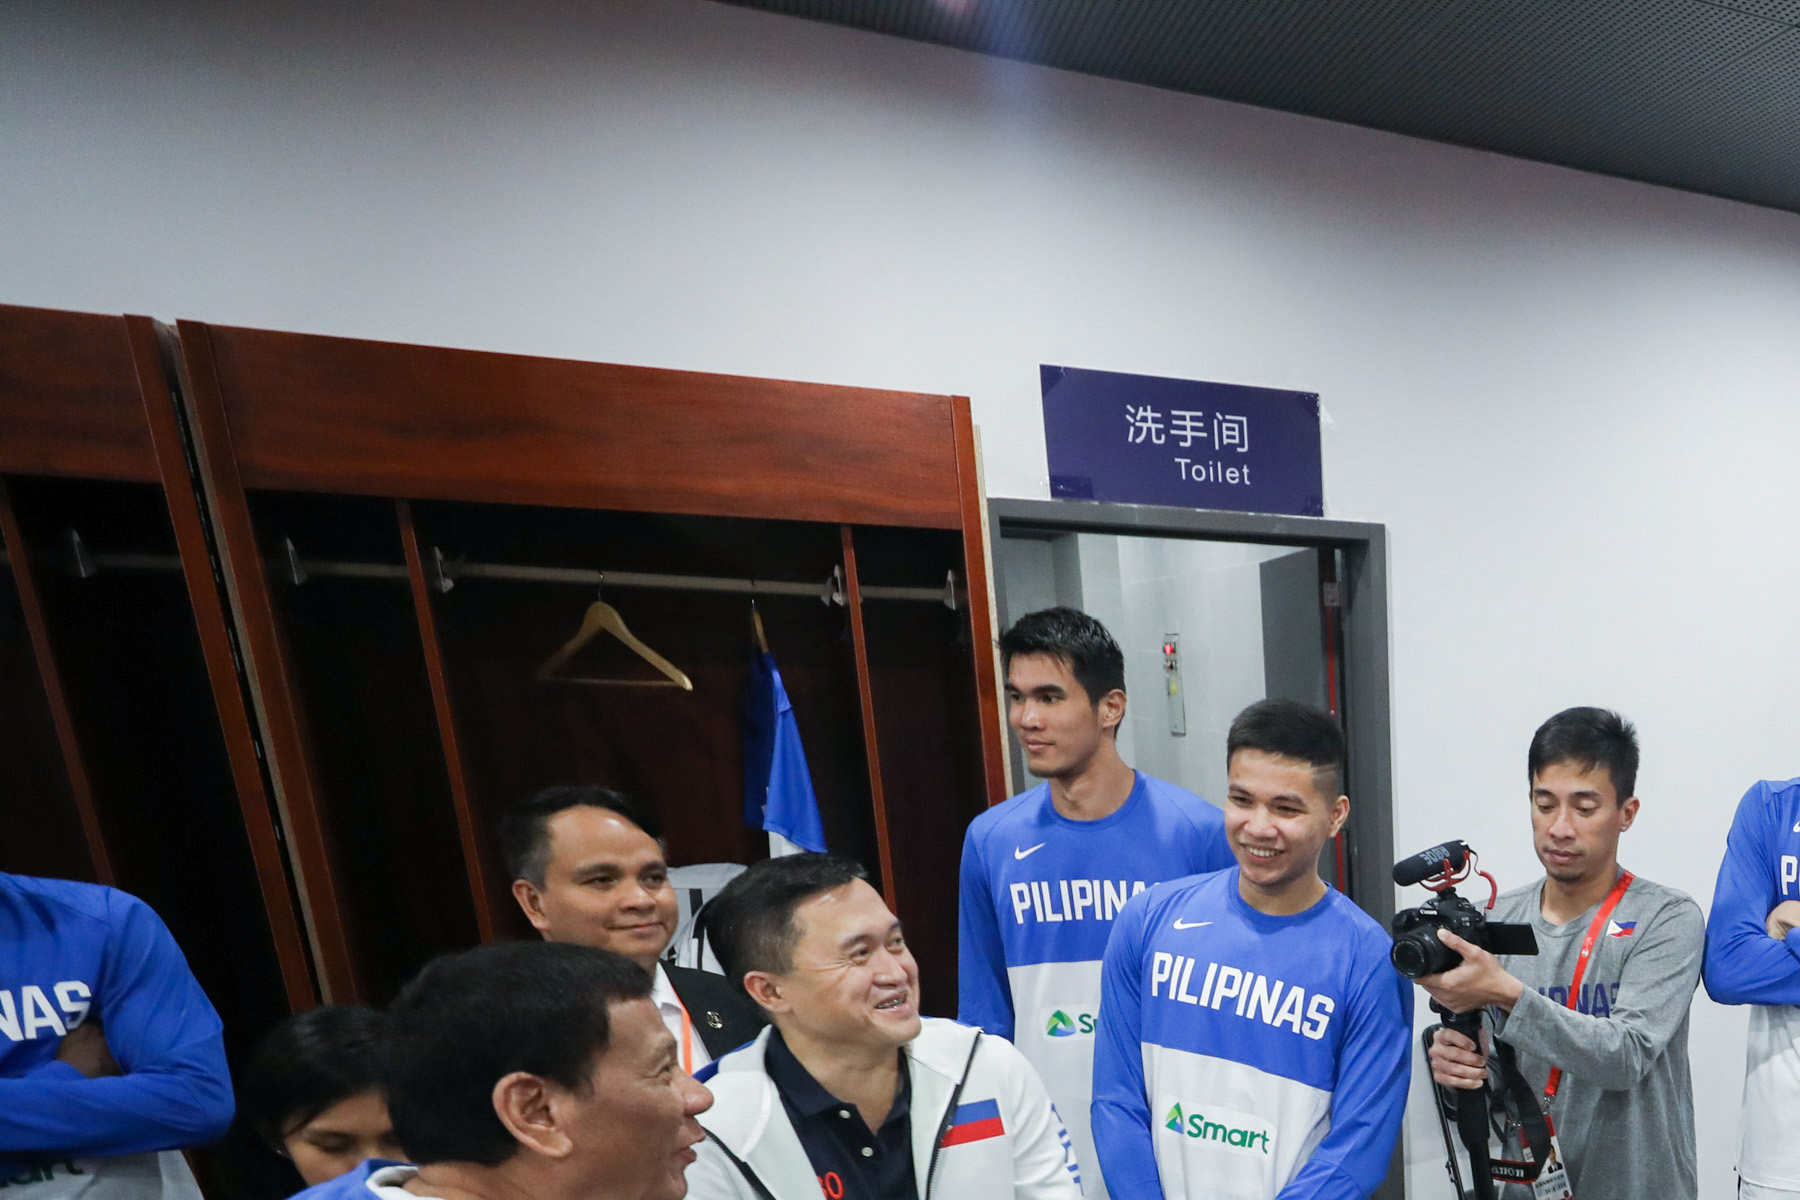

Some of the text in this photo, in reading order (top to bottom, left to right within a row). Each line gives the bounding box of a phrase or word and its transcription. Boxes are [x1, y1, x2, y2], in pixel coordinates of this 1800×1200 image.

[1125, 403, 1249, 453] 洗手间
[1174, 457, 1251, 486] Toilet
[1009, 878, 1161, 925] PILIPIN
[1151, 951, 1336, 1041] PILIPINAS
[1186, 1113, 1271, 1155] Smart
[1491, 1164, 1525, 1178] anon
